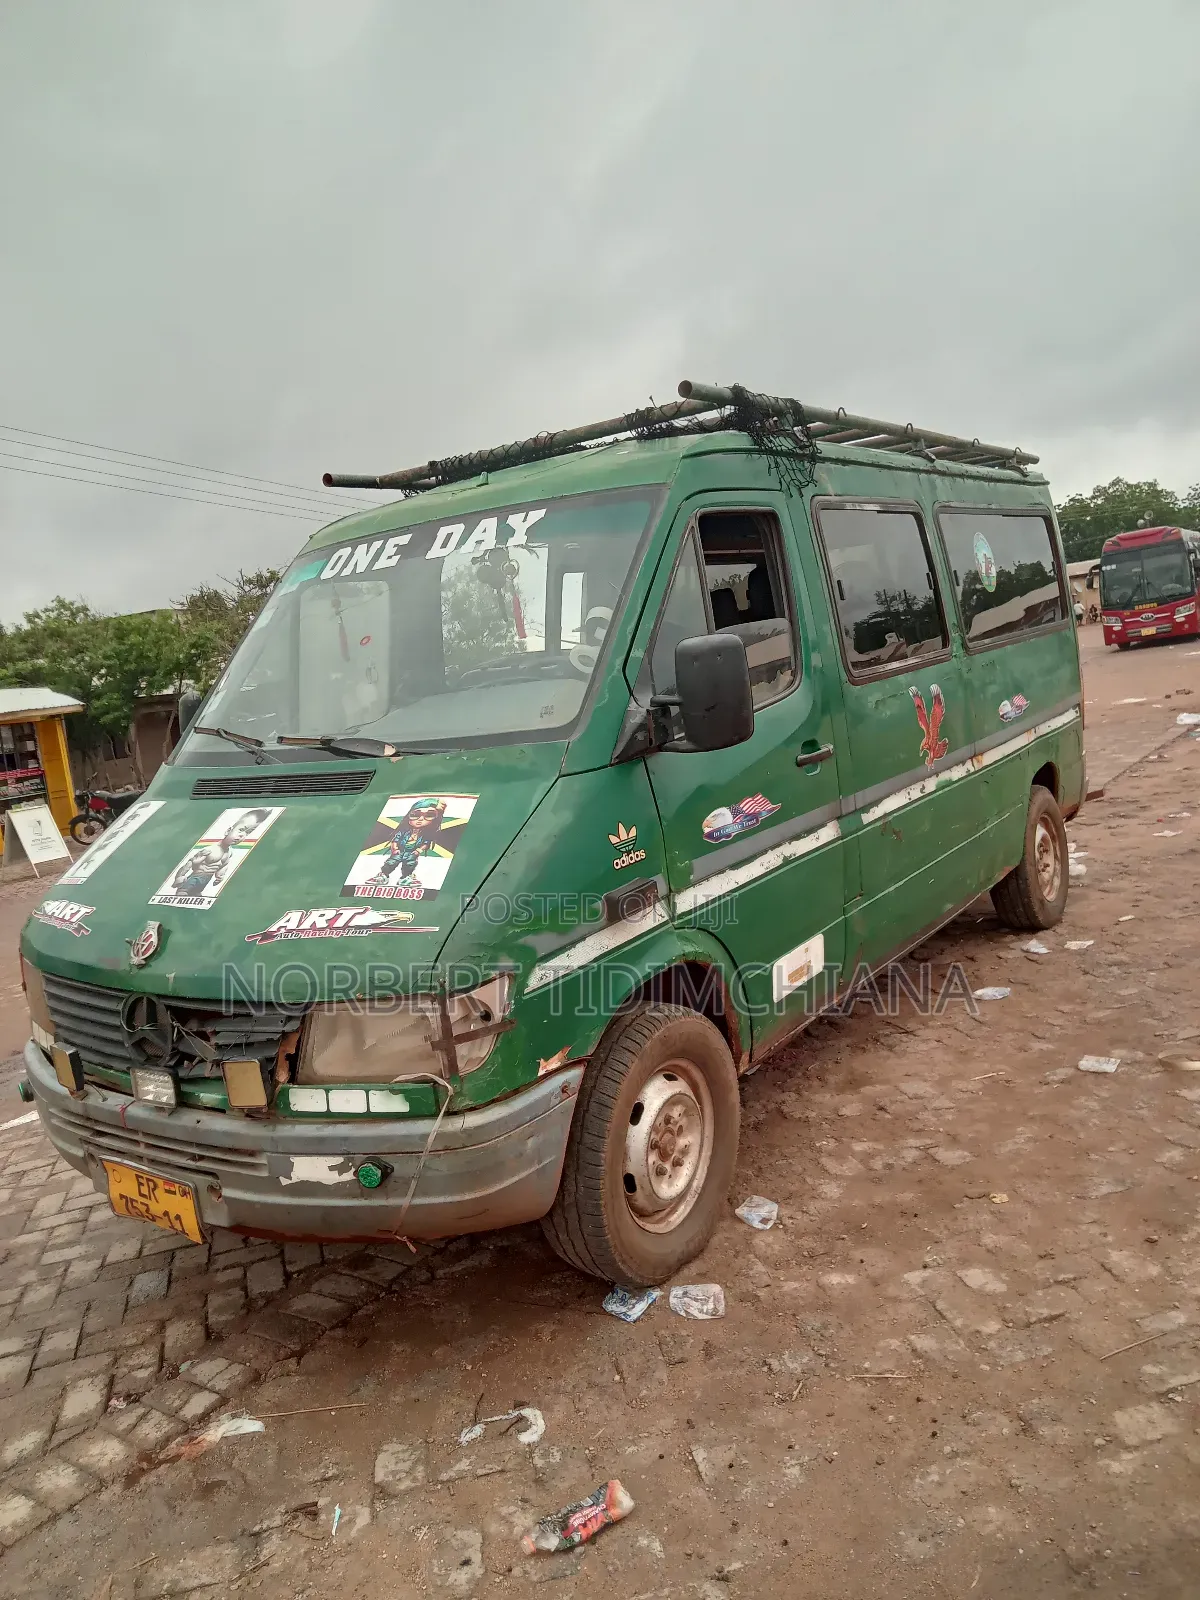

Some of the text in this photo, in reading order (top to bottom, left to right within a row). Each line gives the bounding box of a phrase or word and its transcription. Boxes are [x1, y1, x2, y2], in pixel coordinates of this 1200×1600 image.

[320, 508, 547, 580] ONE DAY
[613, 848, 646, 870] adidas
[355, 886, 423, 900] THE BIG BOSS
[48, 900, 95, 923] ART
[267, 907, 370, 932] ART
[135, 1173, 159, 1203] ER
[119, 1193, 190, 1236] 753-11
